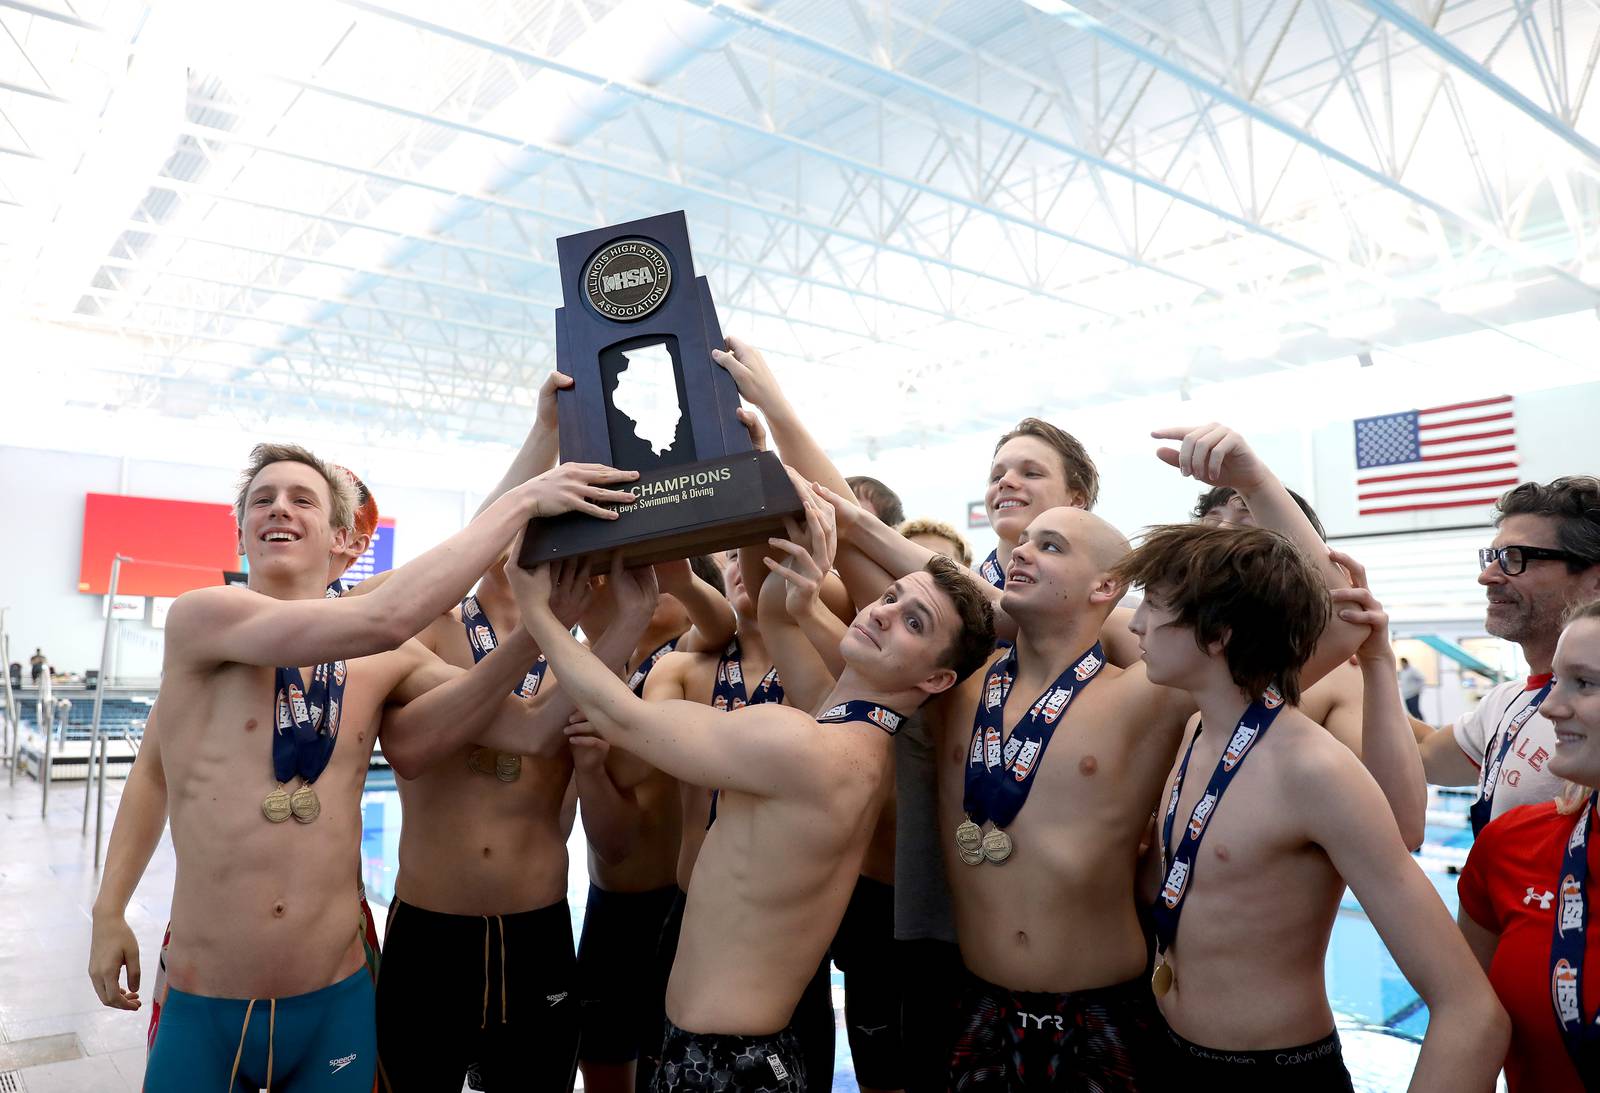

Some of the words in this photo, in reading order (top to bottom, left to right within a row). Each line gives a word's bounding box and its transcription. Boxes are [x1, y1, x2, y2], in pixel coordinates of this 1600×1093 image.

[590, 254, 609, 296] ILLINOIS
[610, 244, 637, 257] HIGH
[639, 246, 667, 280] SCHOOL
[597, 286, 664, 316] ASSOCIATION
[630, 467, 731, 498] CHAMPIONS
[639, 493, 680, 508] Swimming
[681, 490, 688, 500] &
[689, 486, 714, 499] Diving
[1042, 688, 1071, 717] IHSA
[874, 706, 900, 731] IHSA
[1012, 740, 1040, 774] IHSA
[1222, 724, 1255, 767] IHSA
[1189, 792, 1216, 835] IHSA
[1162, 860, 1190, 907] IHSA
[1017, 1011, 1064, 1031] TYR
[329, 1052, 357, 1067] speedo
